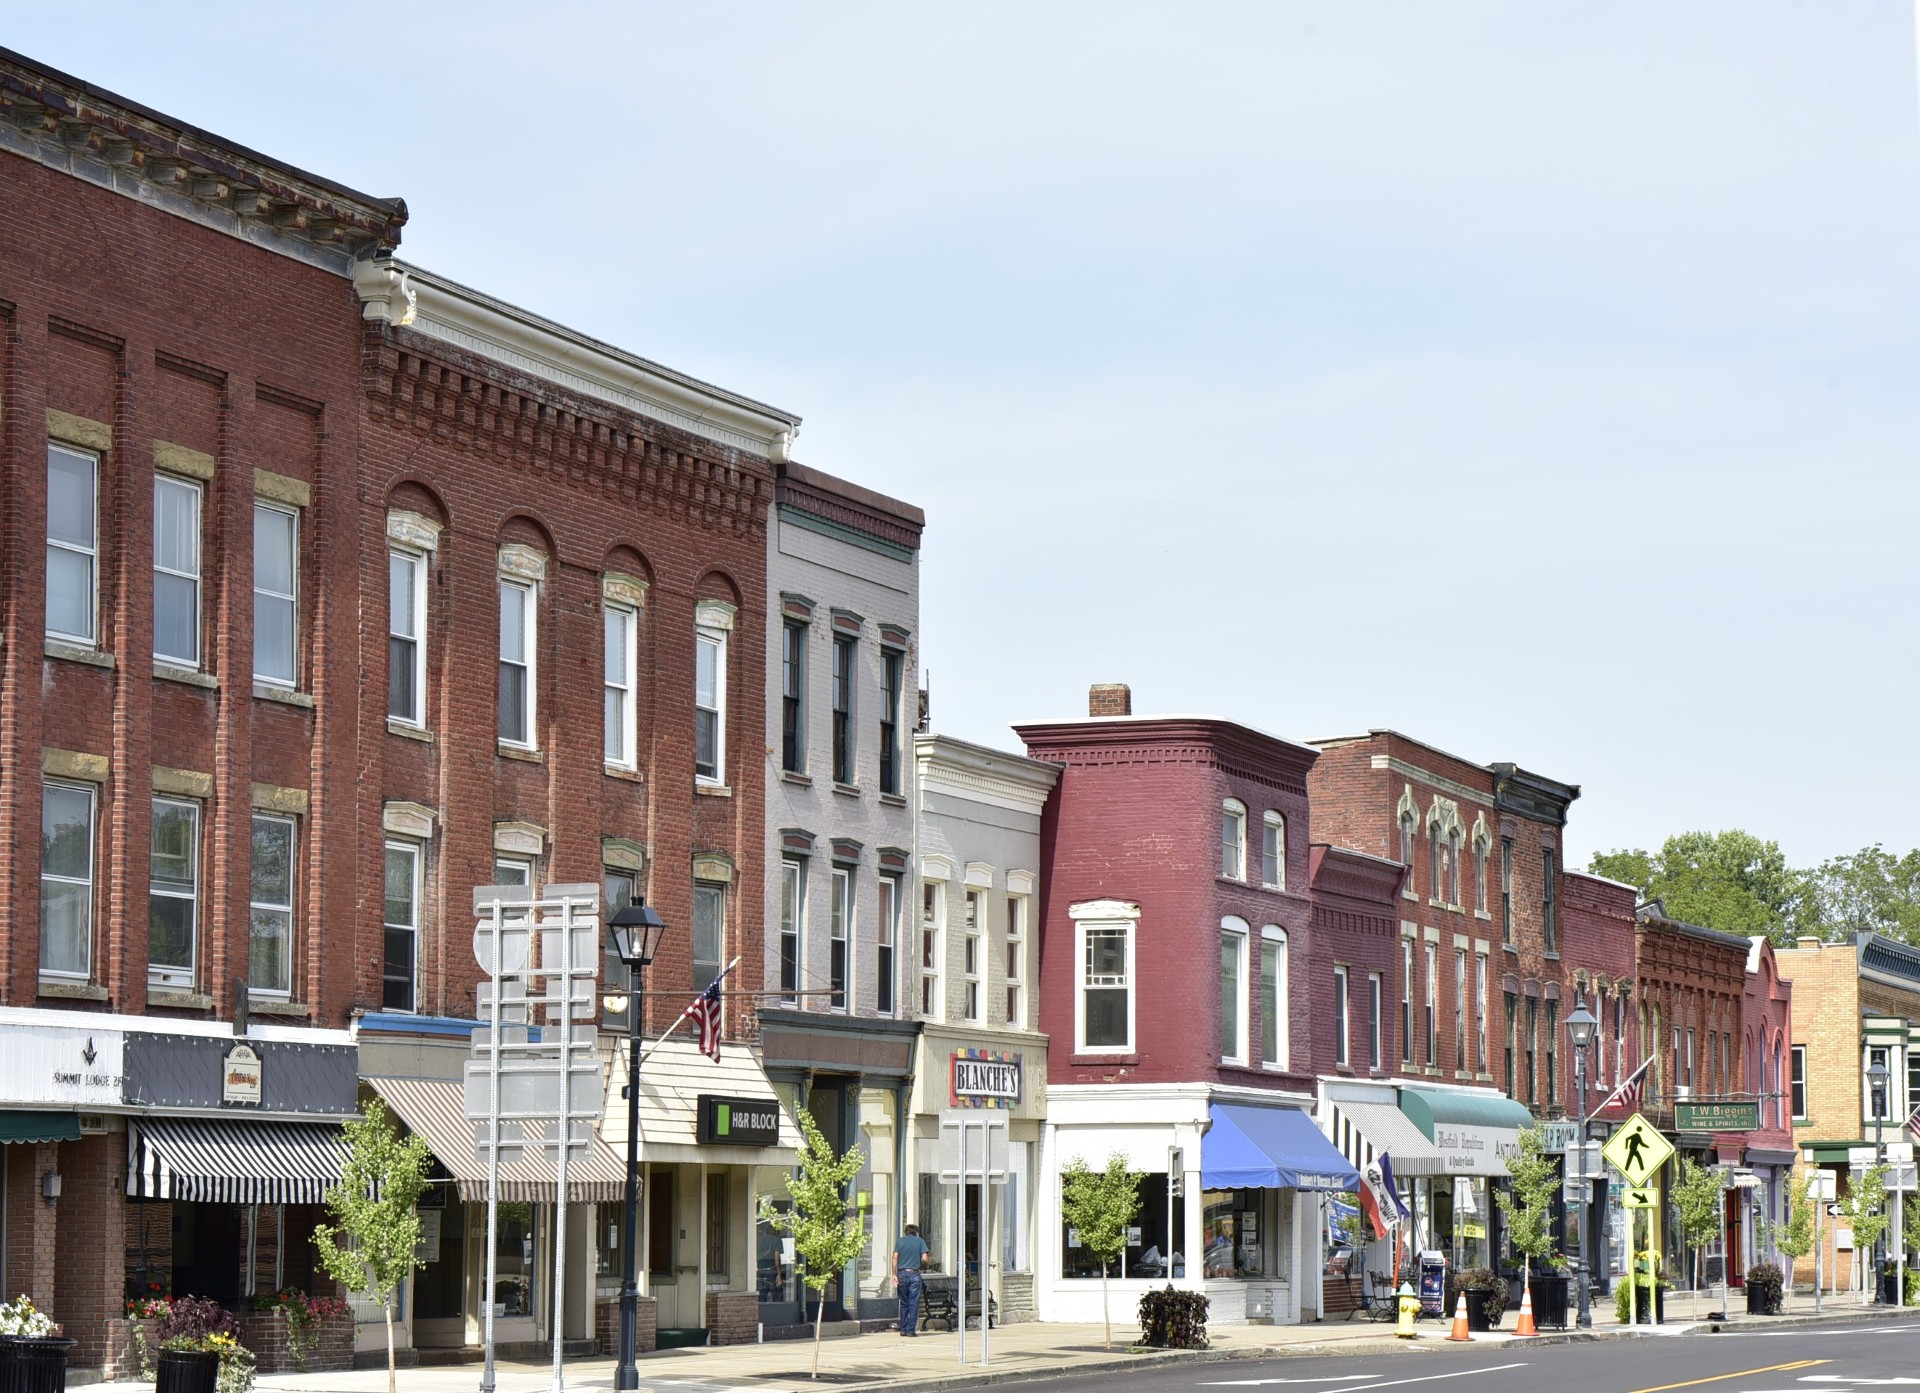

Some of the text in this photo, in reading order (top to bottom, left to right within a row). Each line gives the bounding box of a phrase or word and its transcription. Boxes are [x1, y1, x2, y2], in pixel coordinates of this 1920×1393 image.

[54, 1072, 82, 1085] SUMMIT
[86, 1074, 110, 1087] LODGE
[956, 1064, 1017, 1094] BLANCHE'S
[732, 1111, 777, 1130] H&R BLOCK
